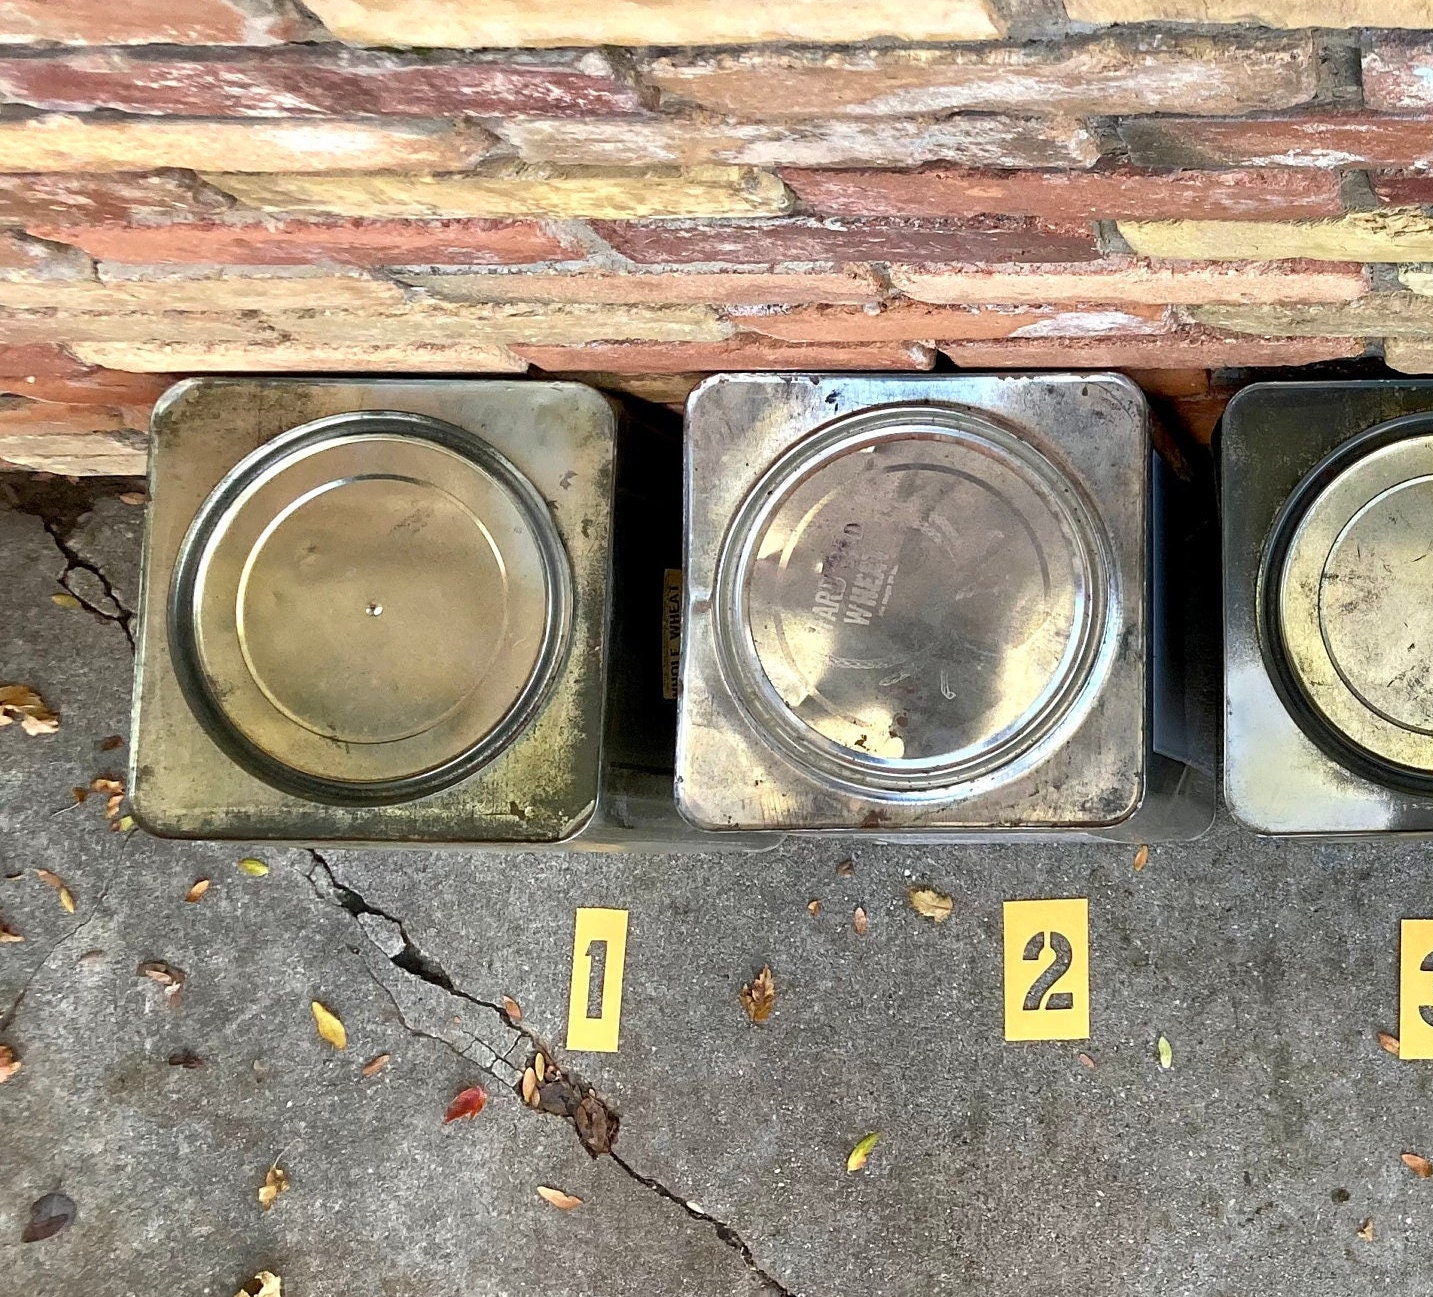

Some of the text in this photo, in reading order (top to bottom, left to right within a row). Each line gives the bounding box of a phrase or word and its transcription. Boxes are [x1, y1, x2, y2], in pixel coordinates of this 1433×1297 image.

[669, 586, 681, 640] WHEAT
[585, 940, 608, 1019] 1
[1022, 931, 1073, 1011] 2
